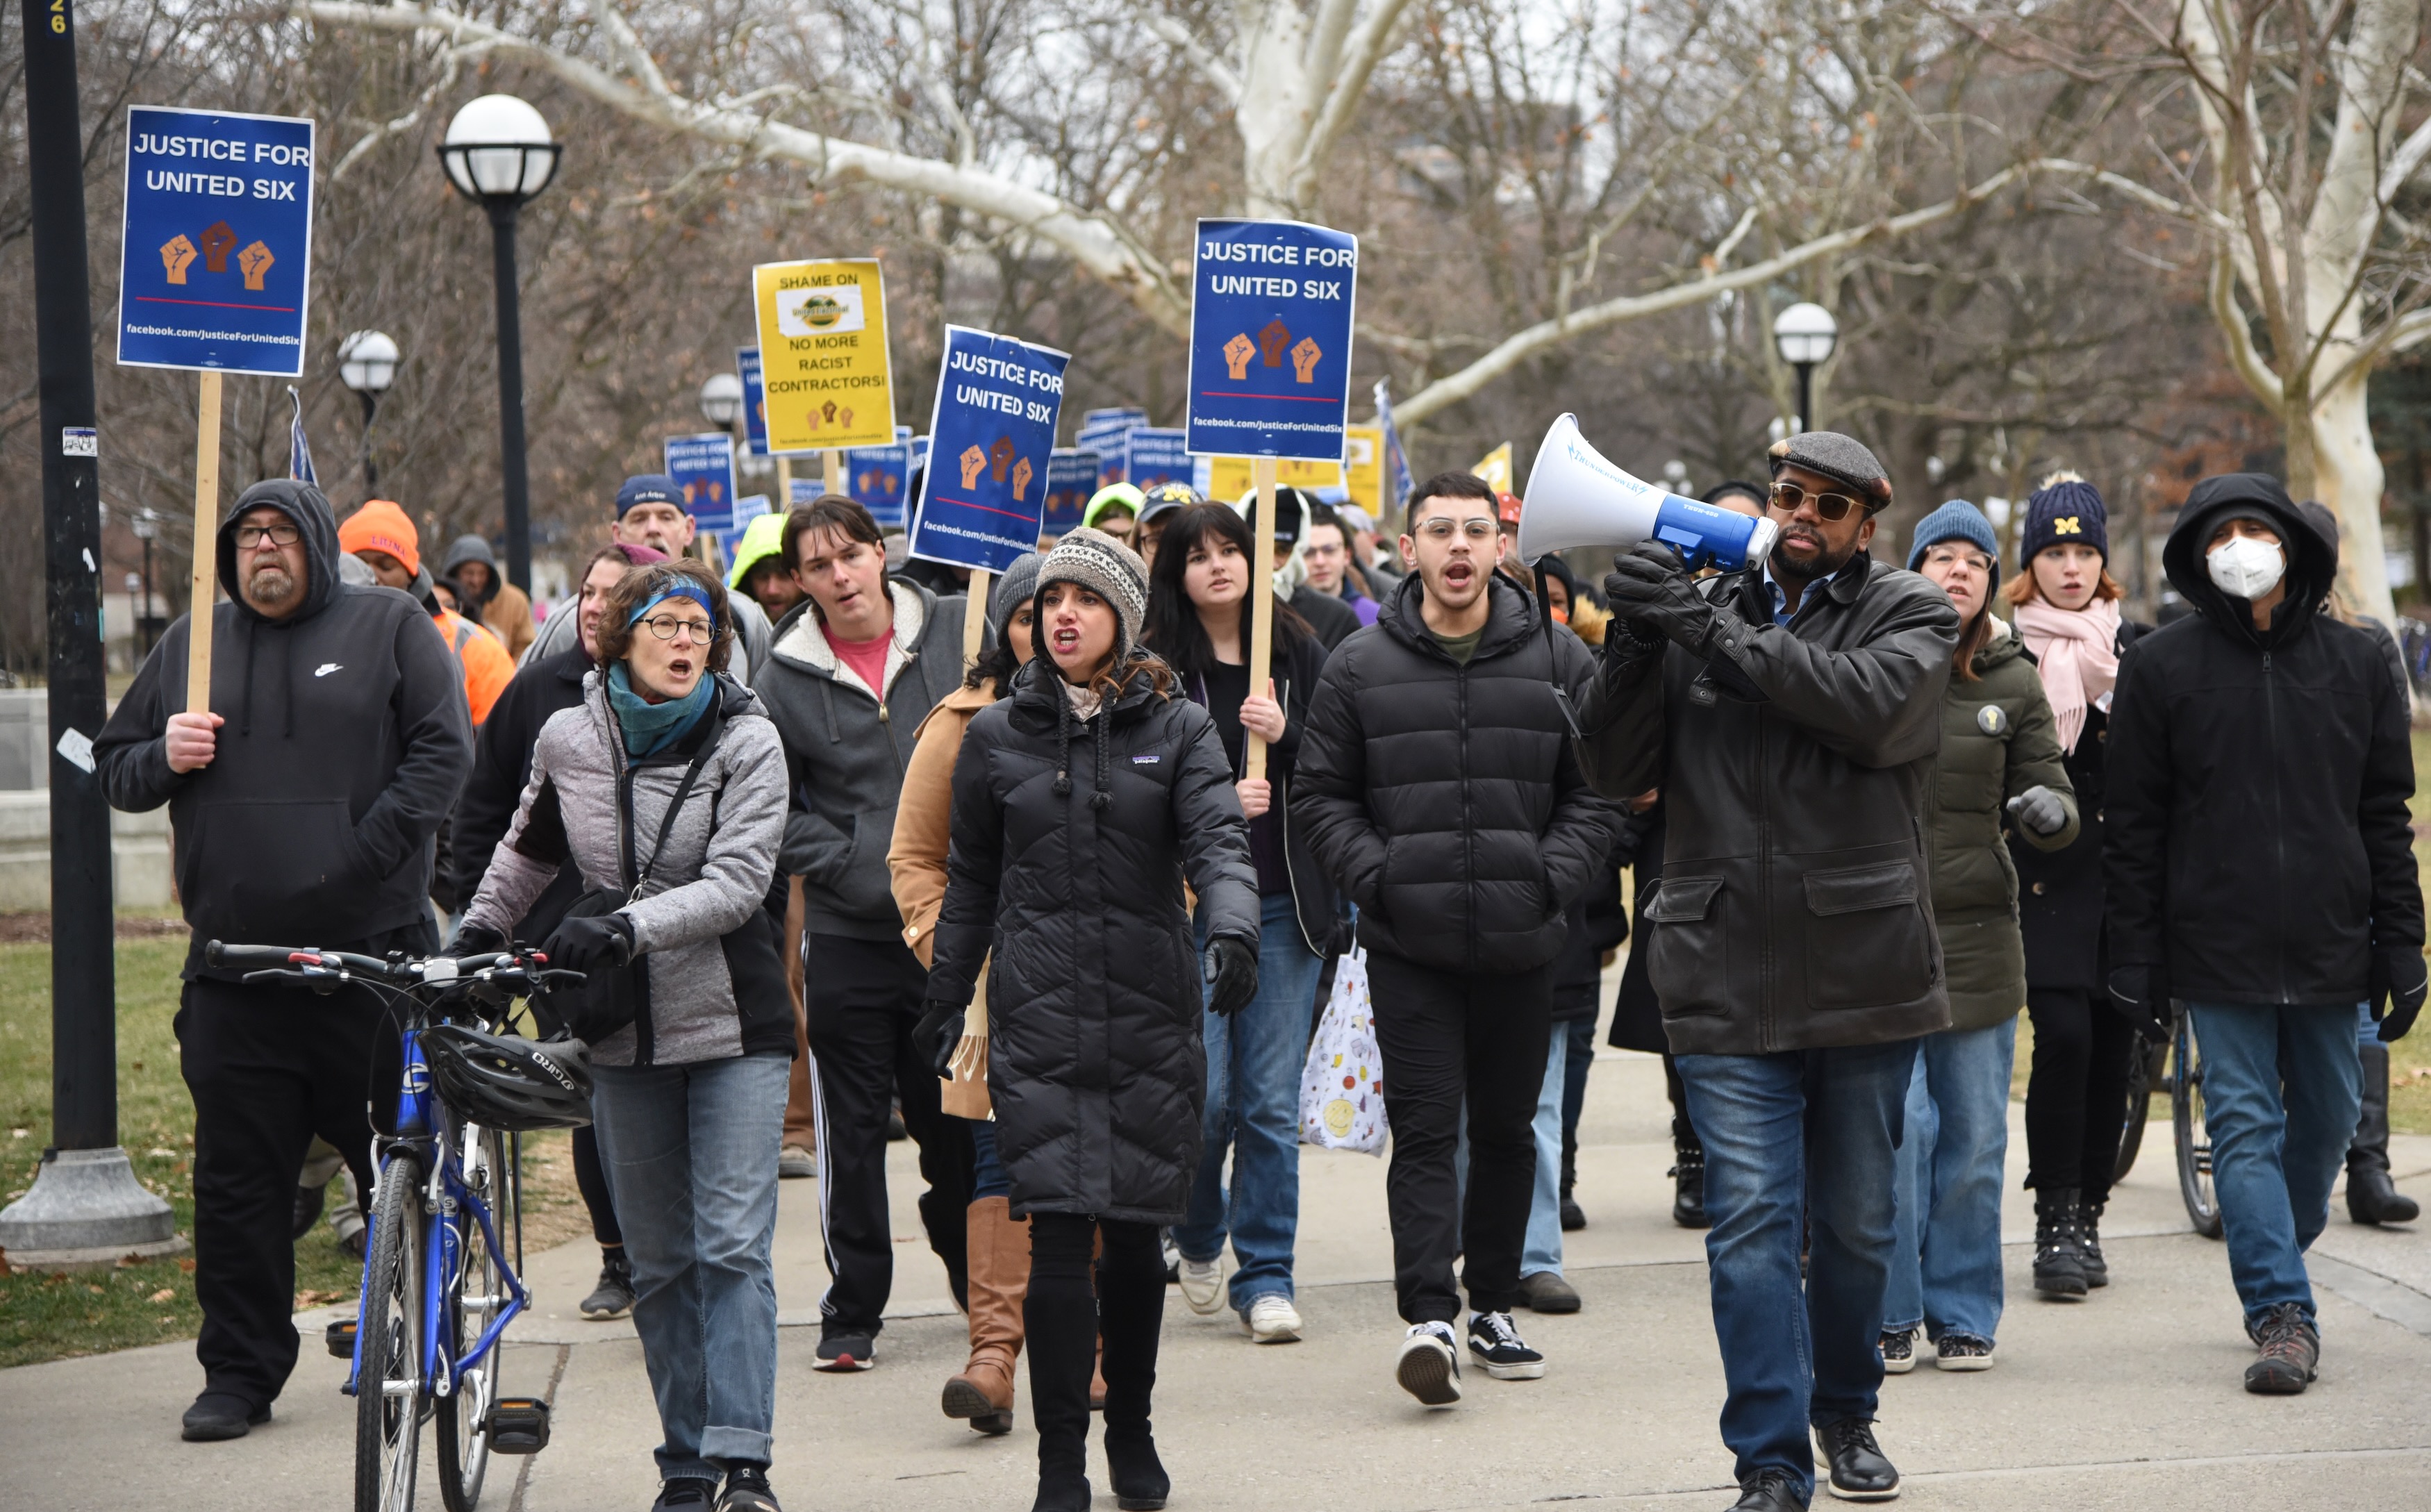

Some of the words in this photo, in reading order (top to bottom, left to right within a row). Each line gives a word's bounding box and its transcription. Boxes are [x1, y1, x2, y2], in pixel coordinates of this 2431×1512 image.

[134, 133, 246, 162] JUSTICE
[254, 142, 310, 167] FOR
[147, 169, 244, 197] UNITED
[252, 178, 296, 201] SIX
[1200, 242, 1299, 265] JUSTICE
[1305, 247, 1354, 267] FOR
[779, 274, 832, 289] SHAME
[836, 273, 858, 285] ON
[1211, 275, 1297, 297] UNITED
[1303, 280, 1341, 300] SIX
[126, 323, 300, 346] facebook.com/JusticeForUnitedSix
[789, 338, 811, 351] NO
[815, 335, 858, 348] MORE
[799, 356, 853, 371] RACIST
[949, 351, 1026, 385] JUSTICE
[1029, 370, 1063, 395] FOR
[768, 375, 885, 393] CONTRACTORS!
[956, 384, 1023, 416] UNITED
[1026, 401, 1052, 424] SIX
[1193, 417, 1343, 433] facebook.com/JusticeForUnitedSix
[2054, 516, 2082, 535] M
[531, 1052, 564, 1081] GIRO
